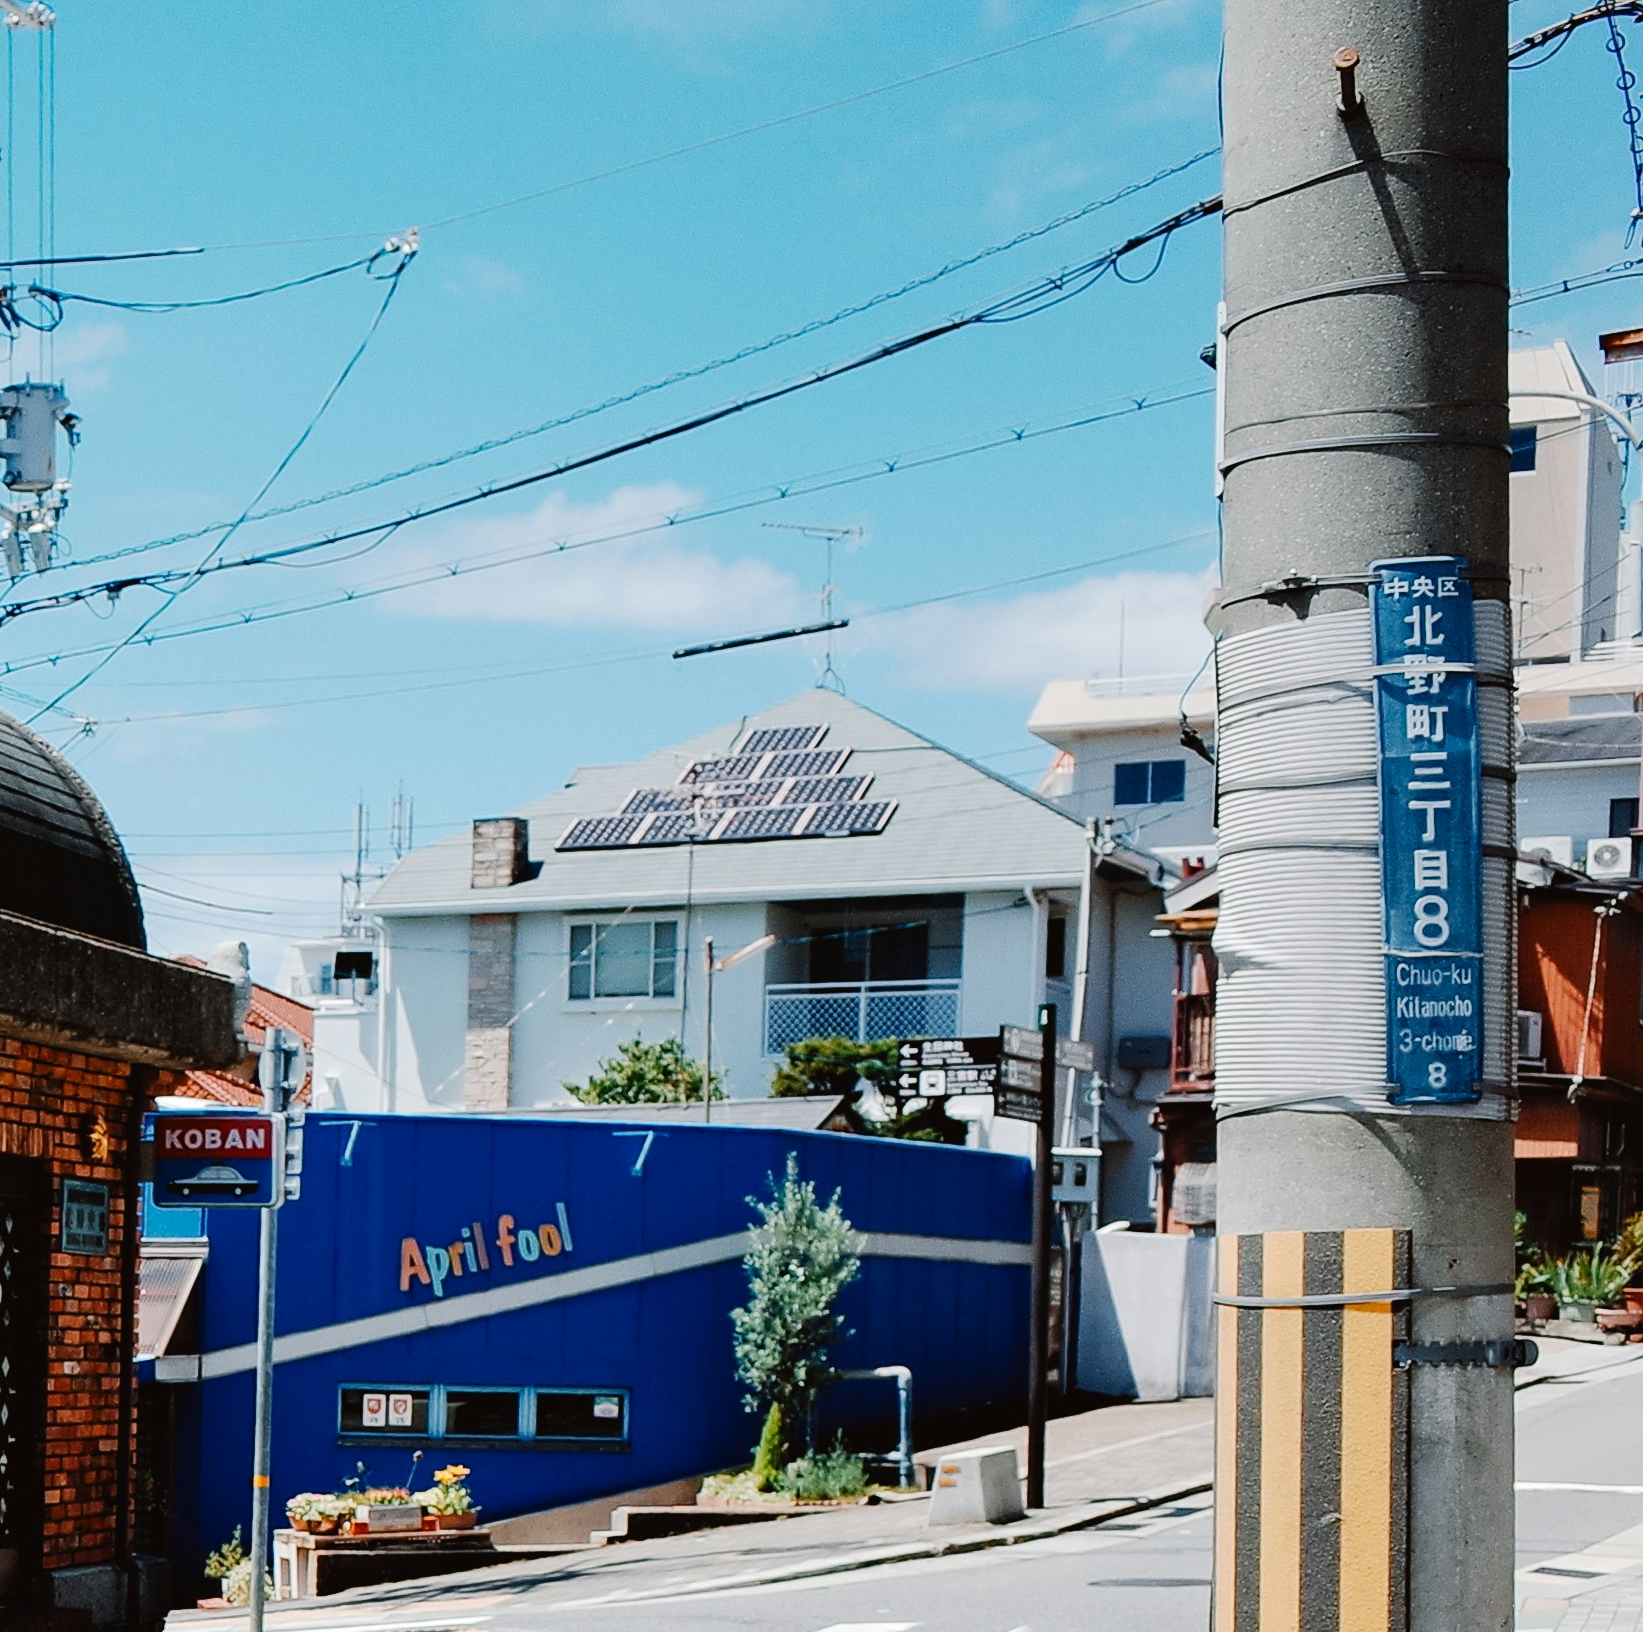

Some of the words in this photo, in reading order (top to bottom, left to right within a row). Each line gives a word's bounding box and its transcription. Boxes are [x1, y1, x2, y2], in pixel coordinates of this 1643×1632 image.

[1383, 575, 1460, 600] 中央区
[1396, 962, 1472, 987] Chuo-ku
[1396, 995, 1473, 1019] Kitanocho
[1427, 1060, 1448, 1089] 8
[164, 1128, 266, 1150] KOBAN
[399, 1222, 490, 1298] April
[495, 1202, 574, 1268] fool
